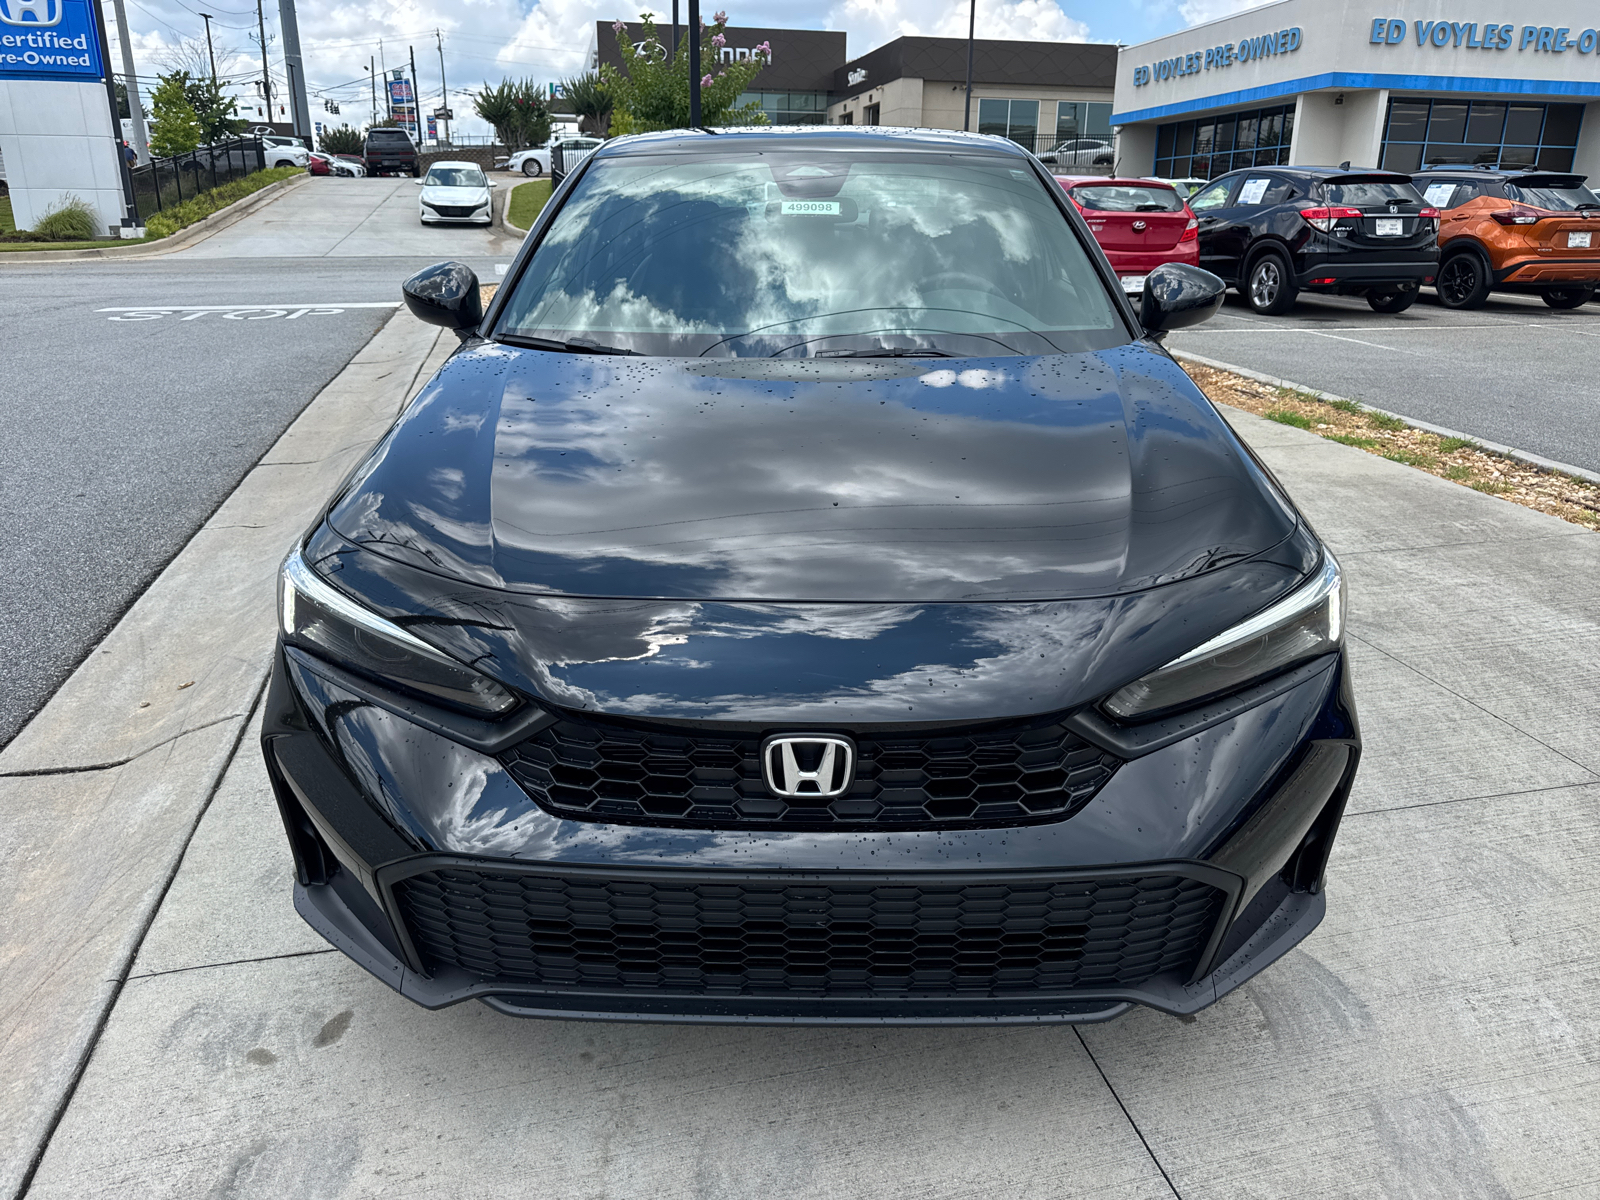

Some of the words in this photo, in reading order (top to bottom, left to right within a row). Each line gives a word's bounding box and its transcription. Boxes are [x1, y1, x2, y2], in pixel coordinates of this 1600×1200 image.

[0, 31, 88, 50] ertified
[1369, 18, 1407, 45] ED
[1414, 20, 1514, 50] VOYLES
[1518, 25, 1600, 54] PRE-O
[0, 51, 91, 67] re-Owned
[1133, 65, 1150, 87] ED
[1152, 51, 1203, 82] VOYLES
[1203, 27, 1303, 70] PRE-OWNED
[788, 203, 832, 212] 499098
[107, 308, 345, 321] STOP
